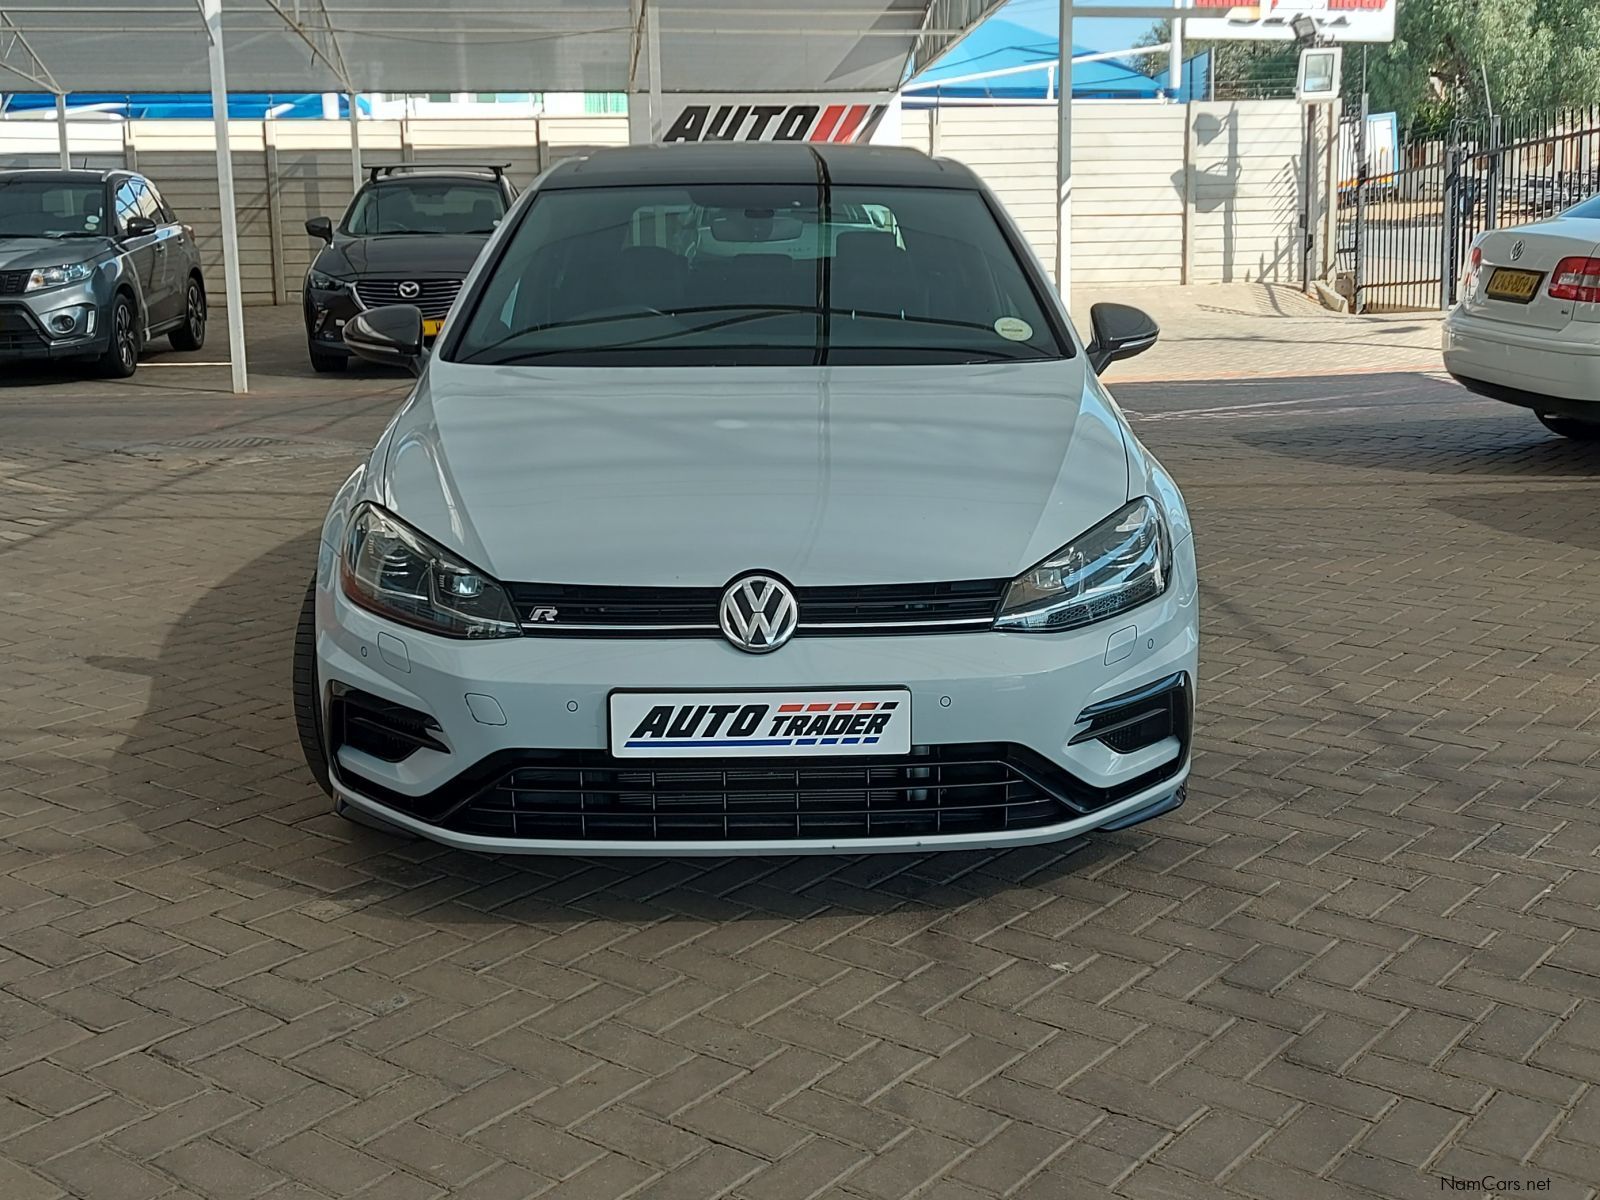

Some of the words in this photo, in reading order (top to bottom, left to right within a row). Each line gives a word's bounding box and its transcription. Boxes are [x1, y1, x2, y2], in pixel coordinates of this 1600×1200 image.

[663, 105, 820, 142] AUTO
[530, 606, 558, 621] R
[629, 704, 770, 738] AUTO
[769, 713, 892, 737] TRADER
